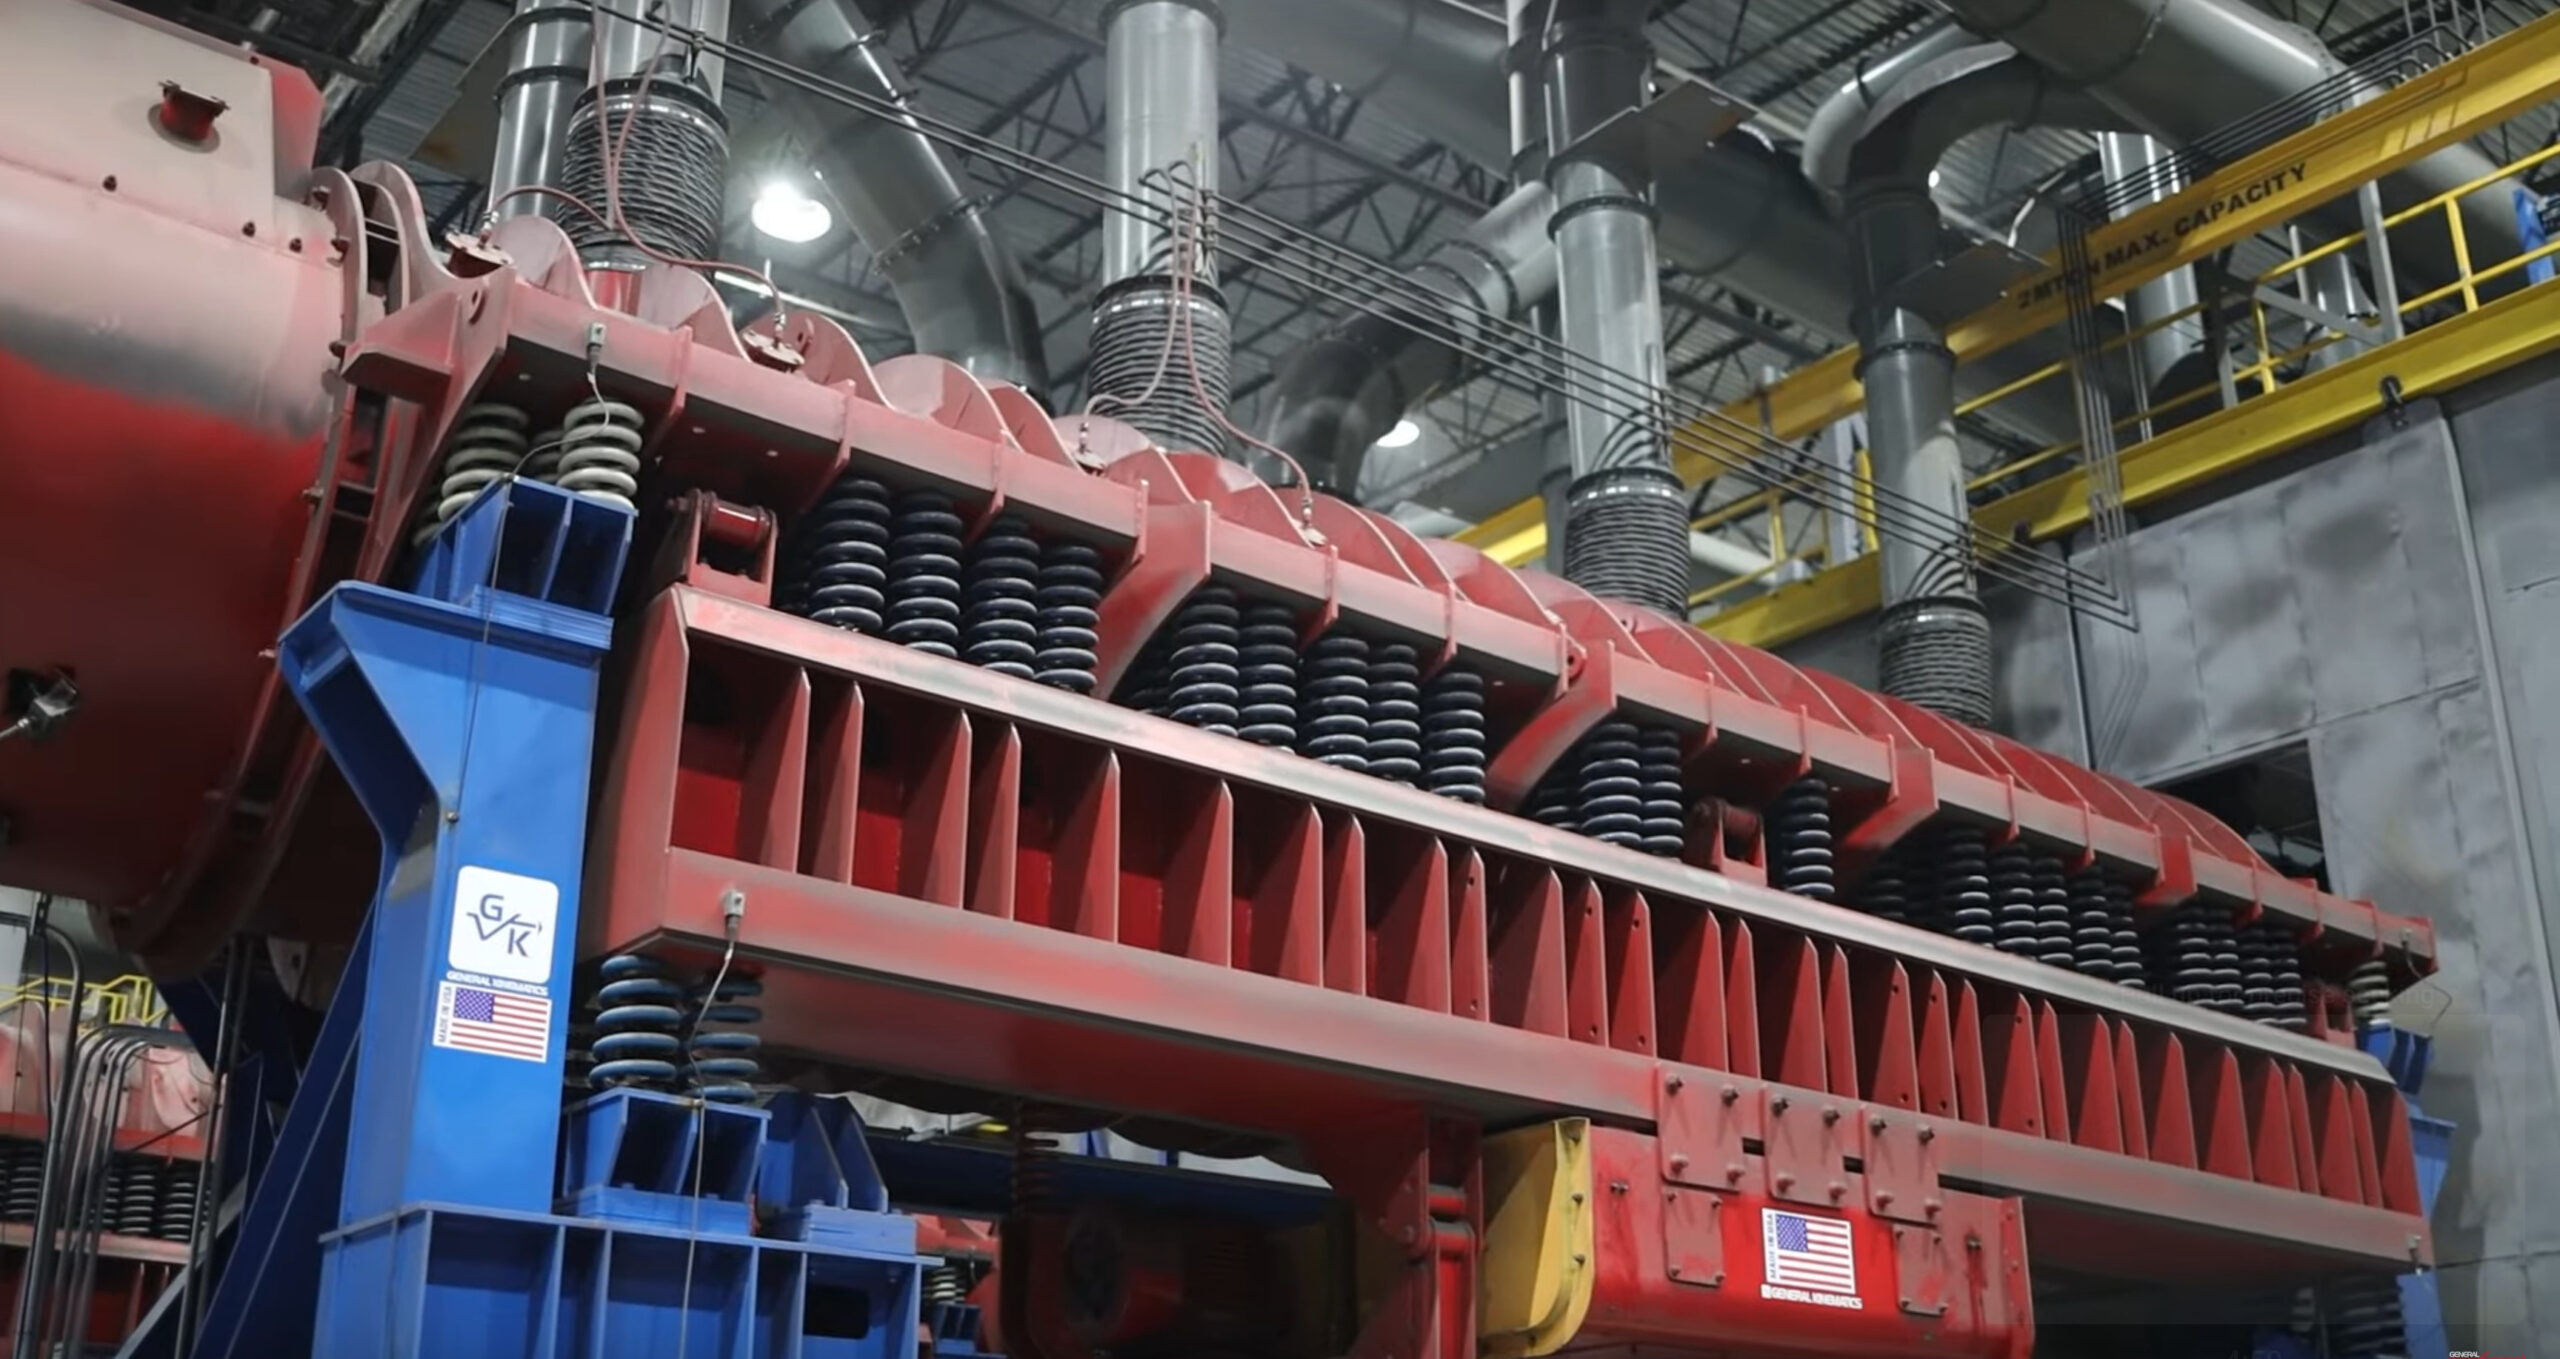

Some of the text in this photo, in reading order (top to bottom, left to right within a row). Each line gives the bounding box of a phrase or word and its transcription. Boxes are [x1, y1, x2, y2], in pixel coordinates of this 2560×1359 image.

[2105, 230, 2168, 269] MAX.
[2174, 162, 2307, 236] CAPACITY
[446, 970, 491, 988] GENERAL
[443, 986, 452, 1004] USA
[441, 1005, 450, 1016] IN
